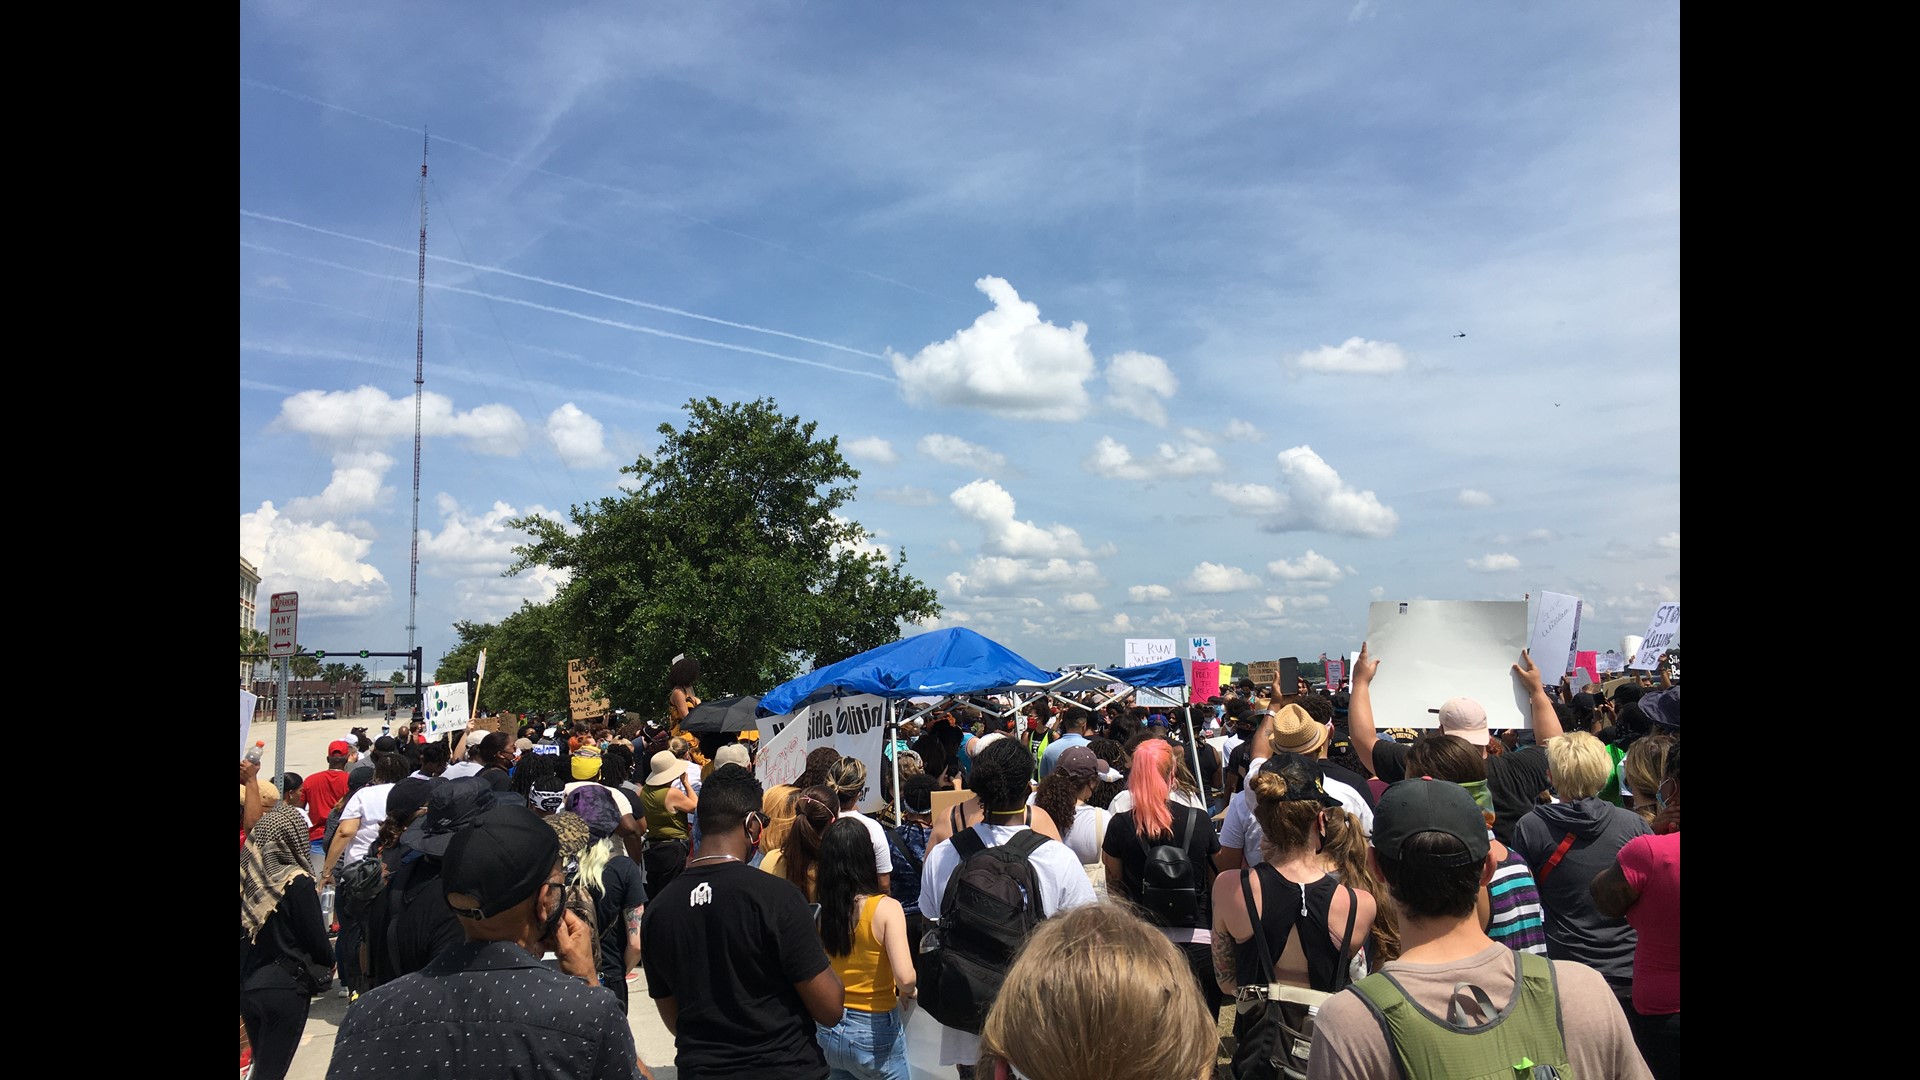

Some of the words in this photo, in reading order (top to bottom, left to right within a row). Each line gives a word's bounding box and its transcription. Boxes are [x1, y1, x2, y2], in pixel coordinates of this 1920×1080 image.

[276, 616, 291, 625] ANY
[275, 628, 291, 637] TIME
[1192, 637, 1210, 648] We
[1128, 642, 1139, 654] I
[1147, 642, 1173, 655] RUN
[1197, 647, 1206, 659] R
